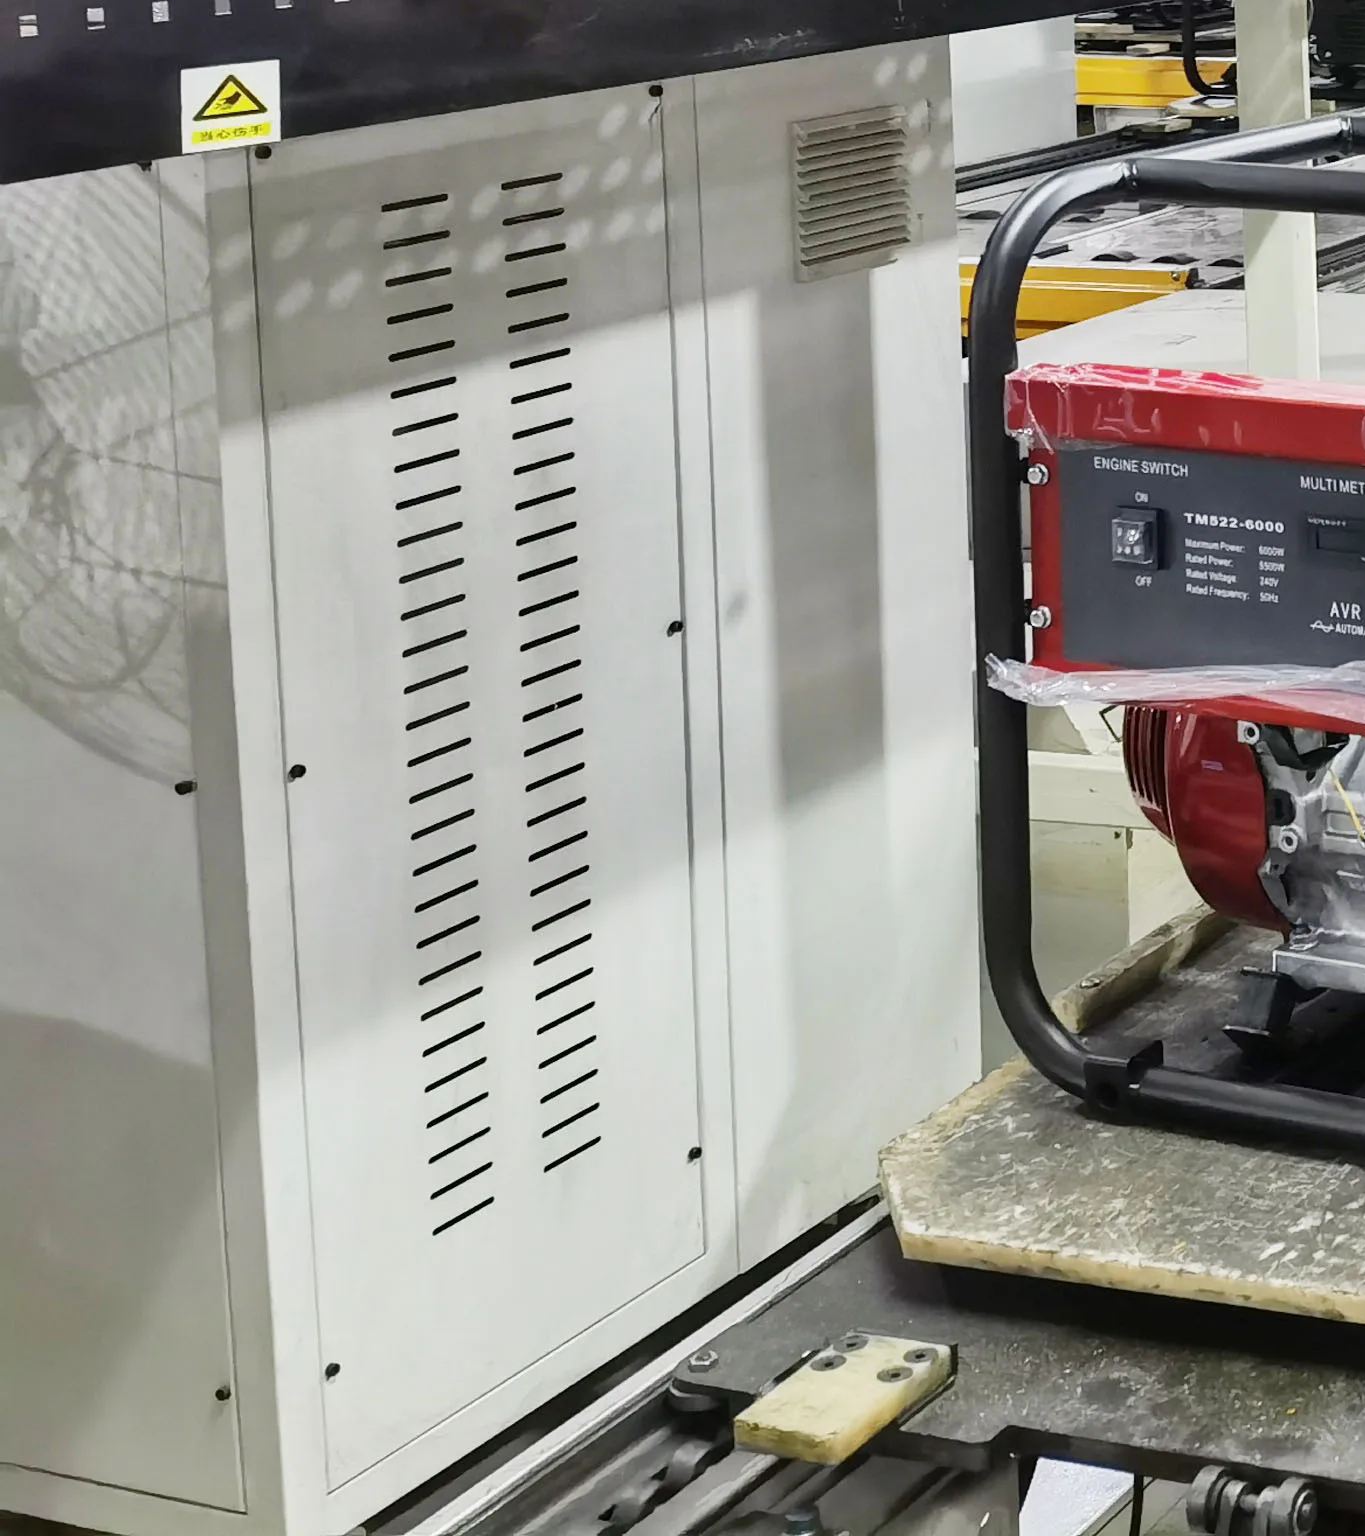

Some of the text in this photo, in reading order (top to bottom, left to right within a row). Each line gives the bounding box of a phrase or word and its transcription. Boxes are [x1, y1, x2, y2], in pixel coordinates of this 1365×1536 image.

[1093, 456, 1189, 477] ENGINE SWITCH
[1300, 475, 1337, 491] MULTI
[1134, 491, 1149, 503] ON
[1183, 512, 1285, 534] TM522-6000
[1185, 553, 1208, 564] Rated
[1185, 568, 1208, 580] Rated
[1135, 575, 1152, 587] OFF
[1186, 583, 1208, 595] Rated
[1329, 601, 1362, 621] AVR
